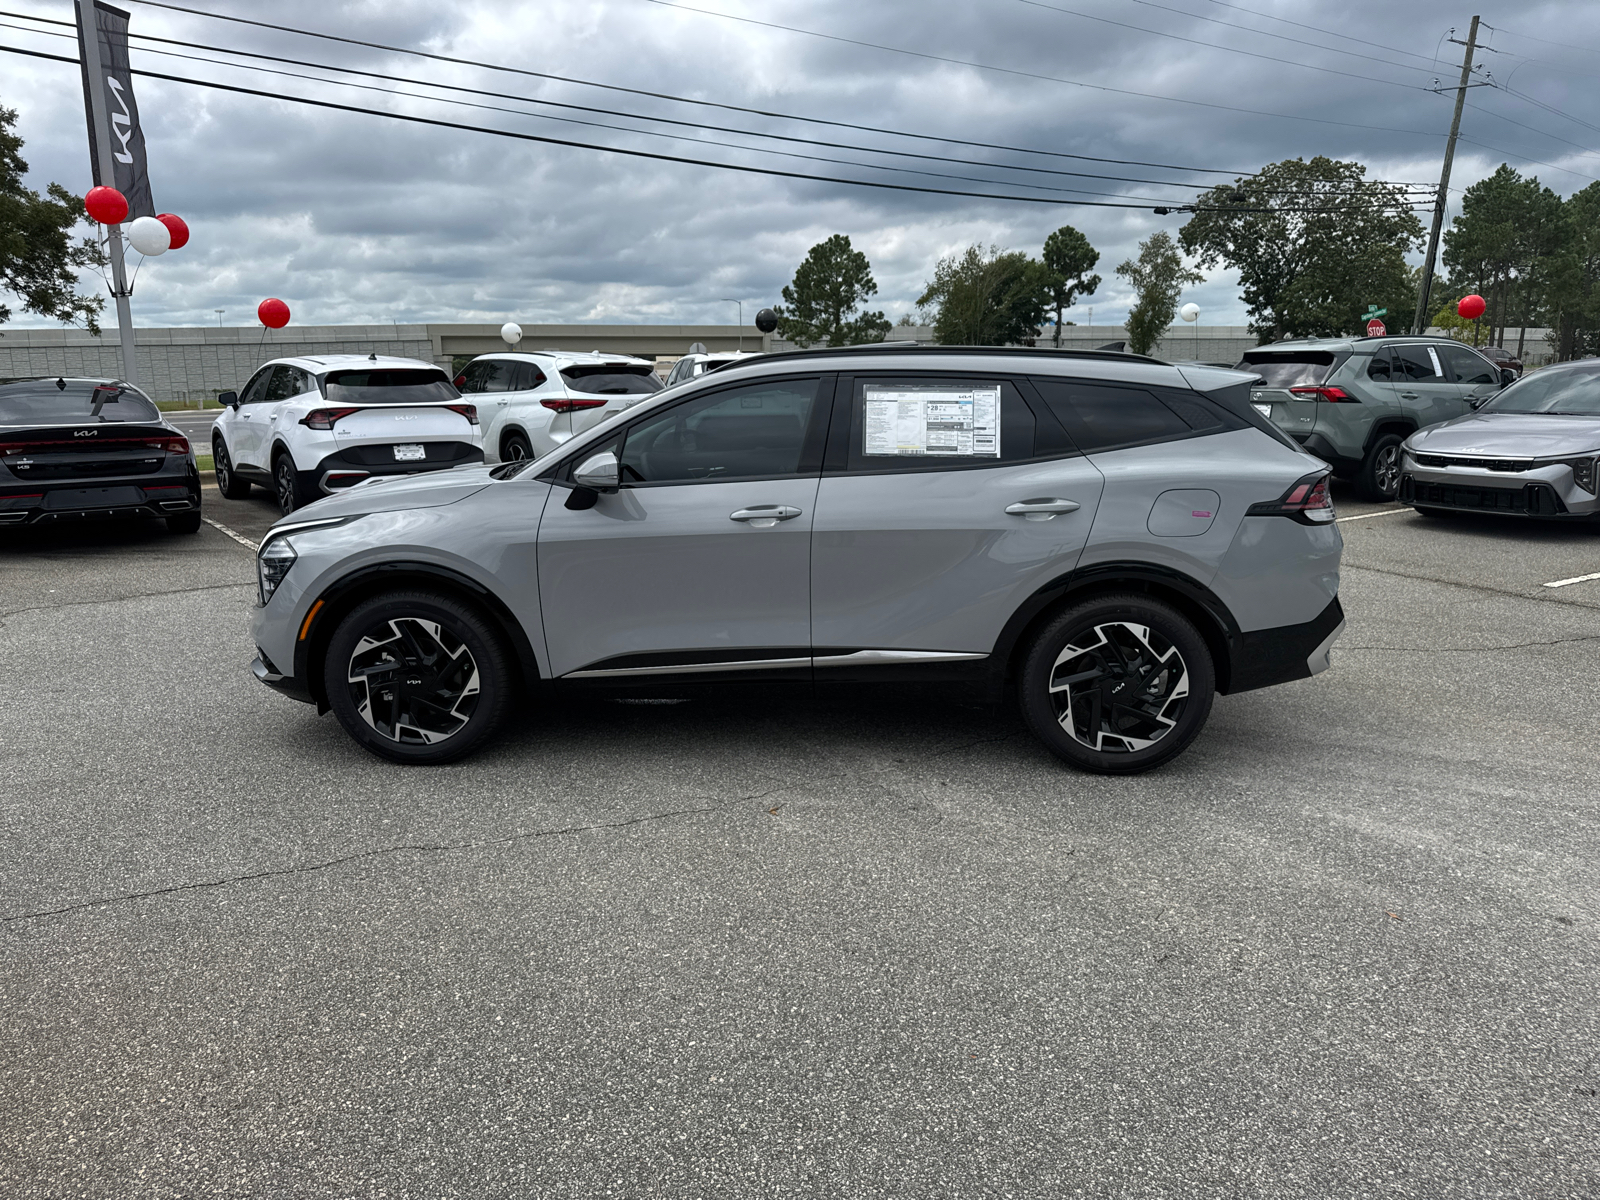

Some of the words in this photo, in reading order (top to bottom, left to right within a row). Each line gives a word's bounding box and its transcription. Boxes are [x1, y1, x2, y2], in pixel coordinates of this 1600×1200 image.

[107, 75, 135, 164] KIA
[1368, 326, 1385, 337] STOP
[73, 429, 98, 437] KIA
[1111, 682, 1125, 694] KIA
